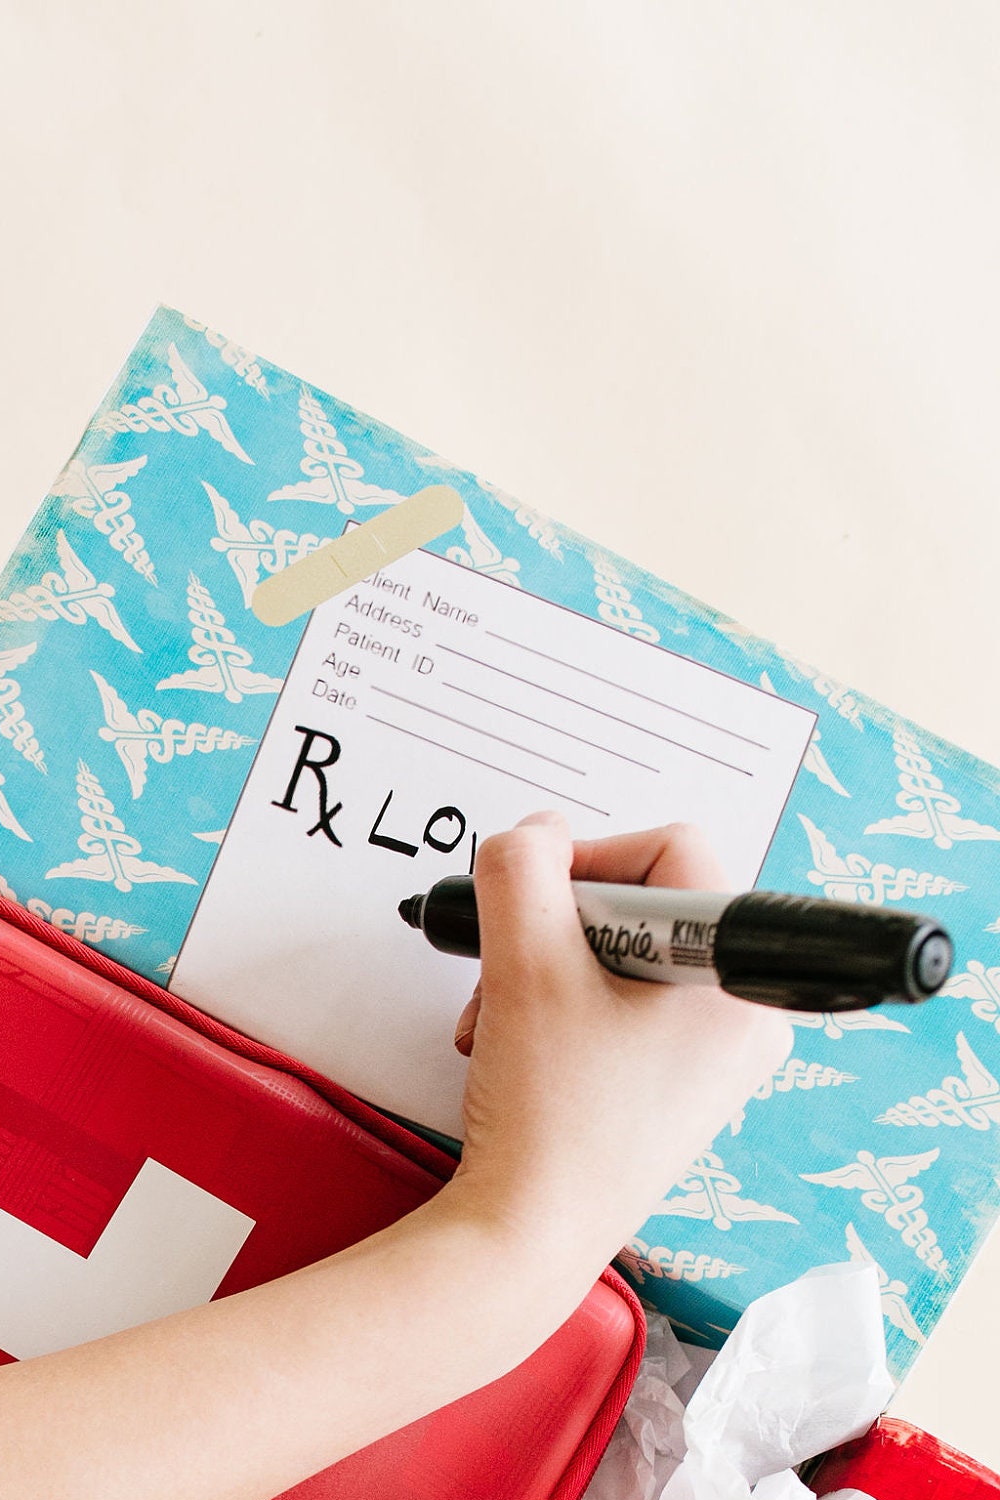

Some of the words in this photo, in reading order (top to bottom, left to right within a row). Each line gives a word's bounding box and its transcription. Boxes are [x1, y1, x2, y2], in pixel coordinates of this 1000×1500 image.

[343, 592, 425, 639] Address
[421, 590, 481, 628] Name
[319, 650, 363, 684] Age
[333, 621, 403, 664] Patient
[411, 654, 435, 677] ID
[311, 678, 360, 711] Date
[588, 922, 659, 966] arpie
